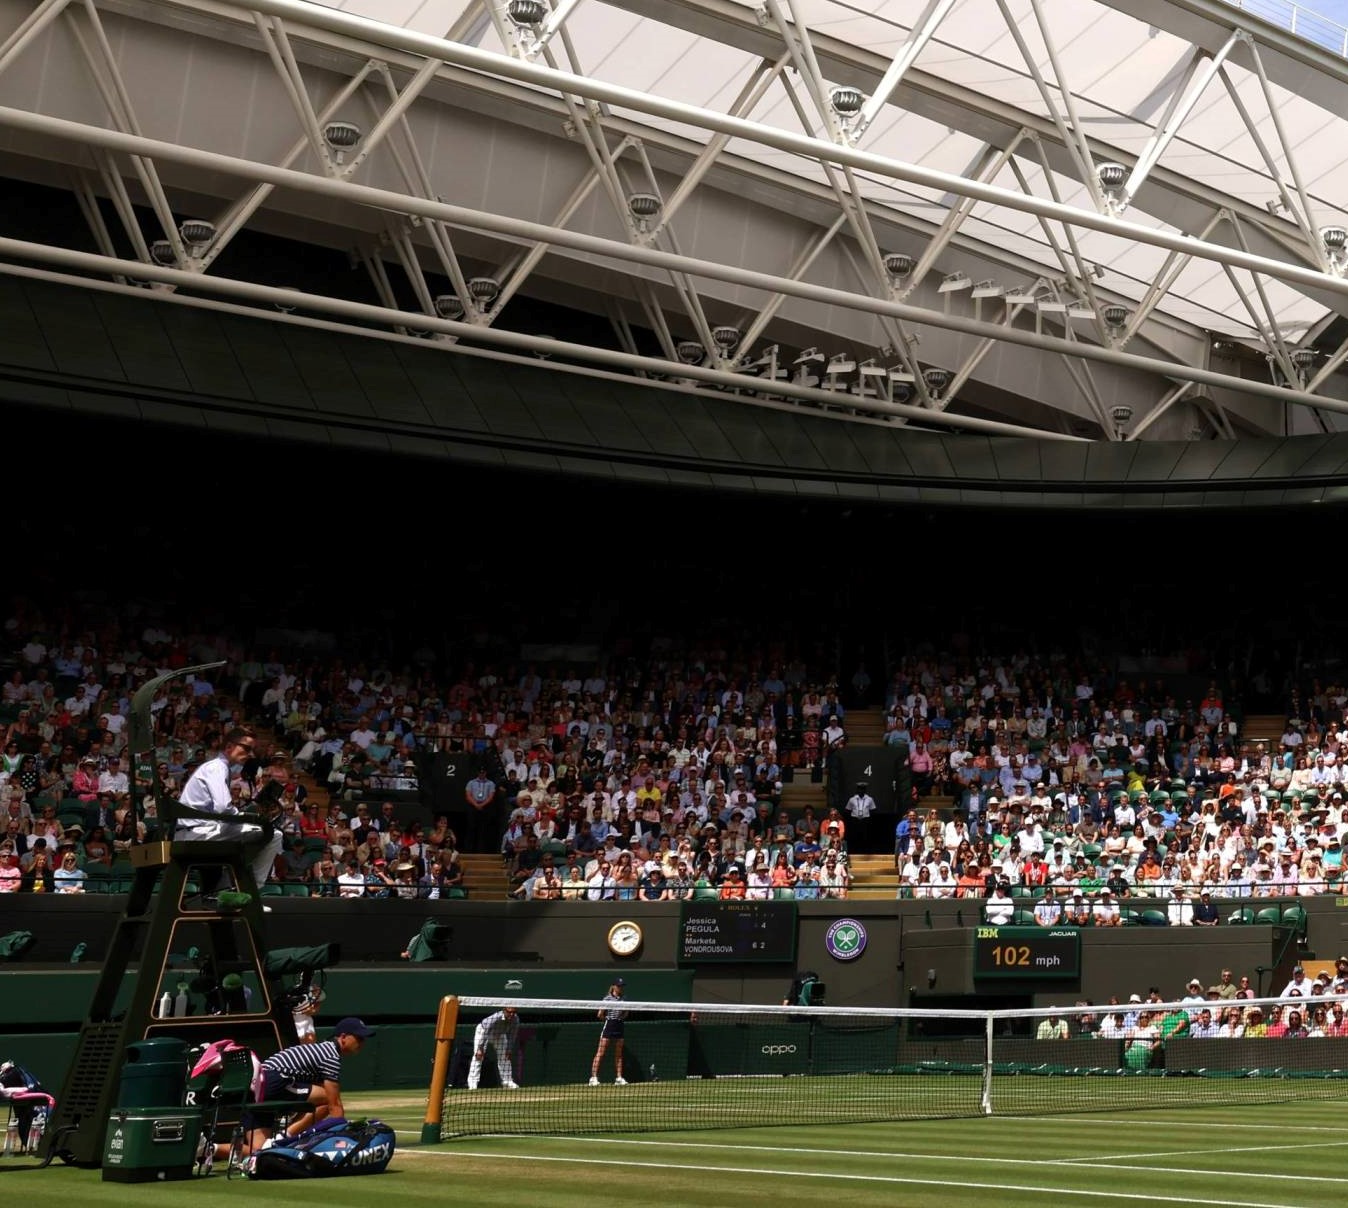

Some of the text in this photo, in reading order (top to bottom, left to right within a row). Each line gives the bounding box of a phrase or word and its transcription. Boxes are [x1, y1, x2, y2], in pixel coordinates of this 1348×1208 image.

[446, 764, 456, 777] 2
[864, 764, 872, 777] 4
[686, 917, 717, 925] Jessica
[686, 925, 720, 933] PEGULA
[977, 928, 999, 938] IBM
[684, 945, 734, 953] VONDROUSOVA
[992, 946, 1060, 967] 102 mph
[761, 1044, 797, 1056] oppo
